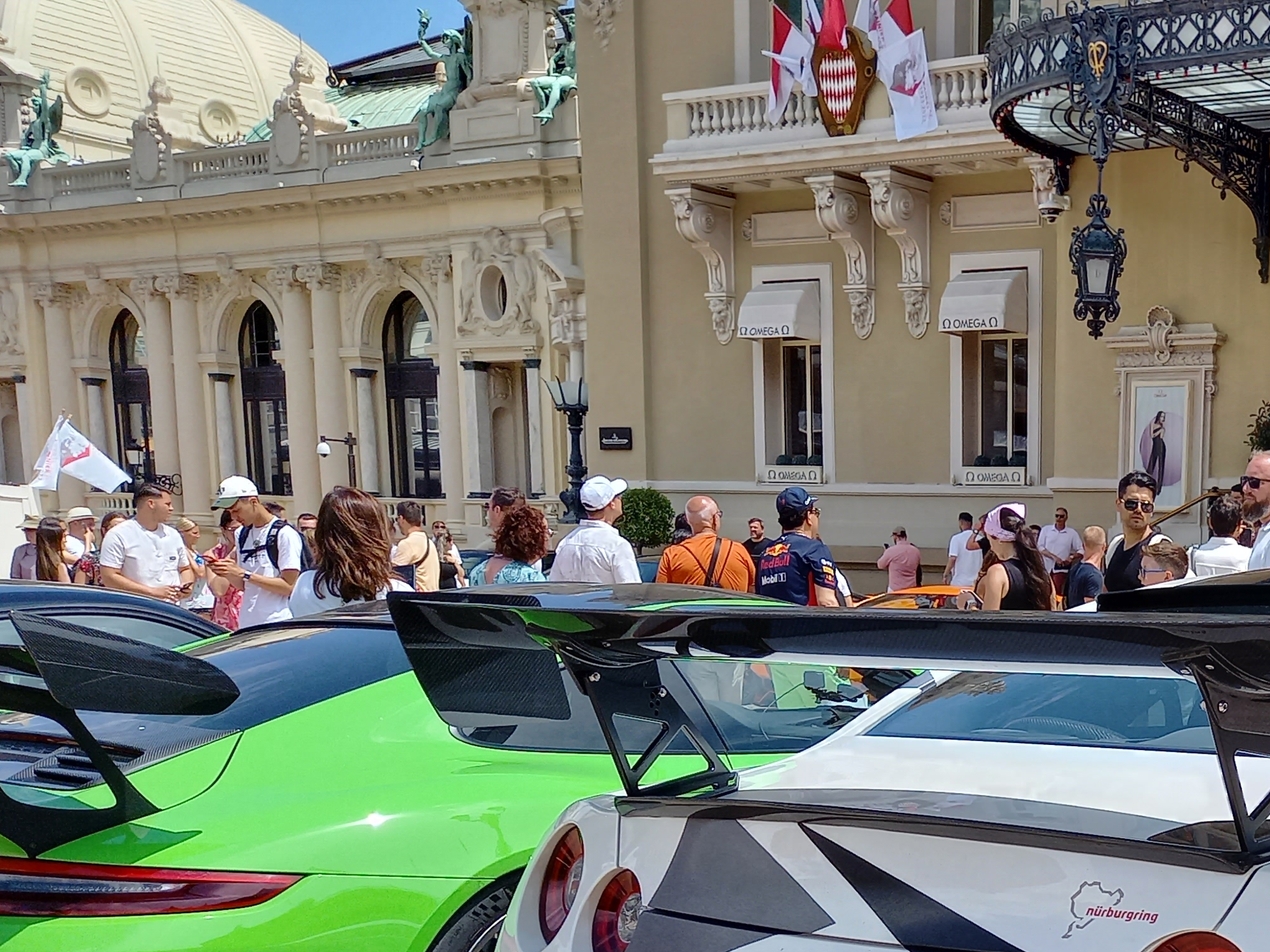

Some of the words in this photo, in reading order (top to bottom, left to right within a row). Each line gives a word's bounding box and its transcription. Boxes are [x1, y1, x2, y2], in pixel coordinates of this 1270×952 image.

[953, 317, 986, 328] OMEGA
[750, 327, 779, 336] OMEGA
[778, 470, 807, 481] OMEGA
[976, 472, 1009, 482] OMEGA
[1086, 905, 1159, 924] nürburgring
